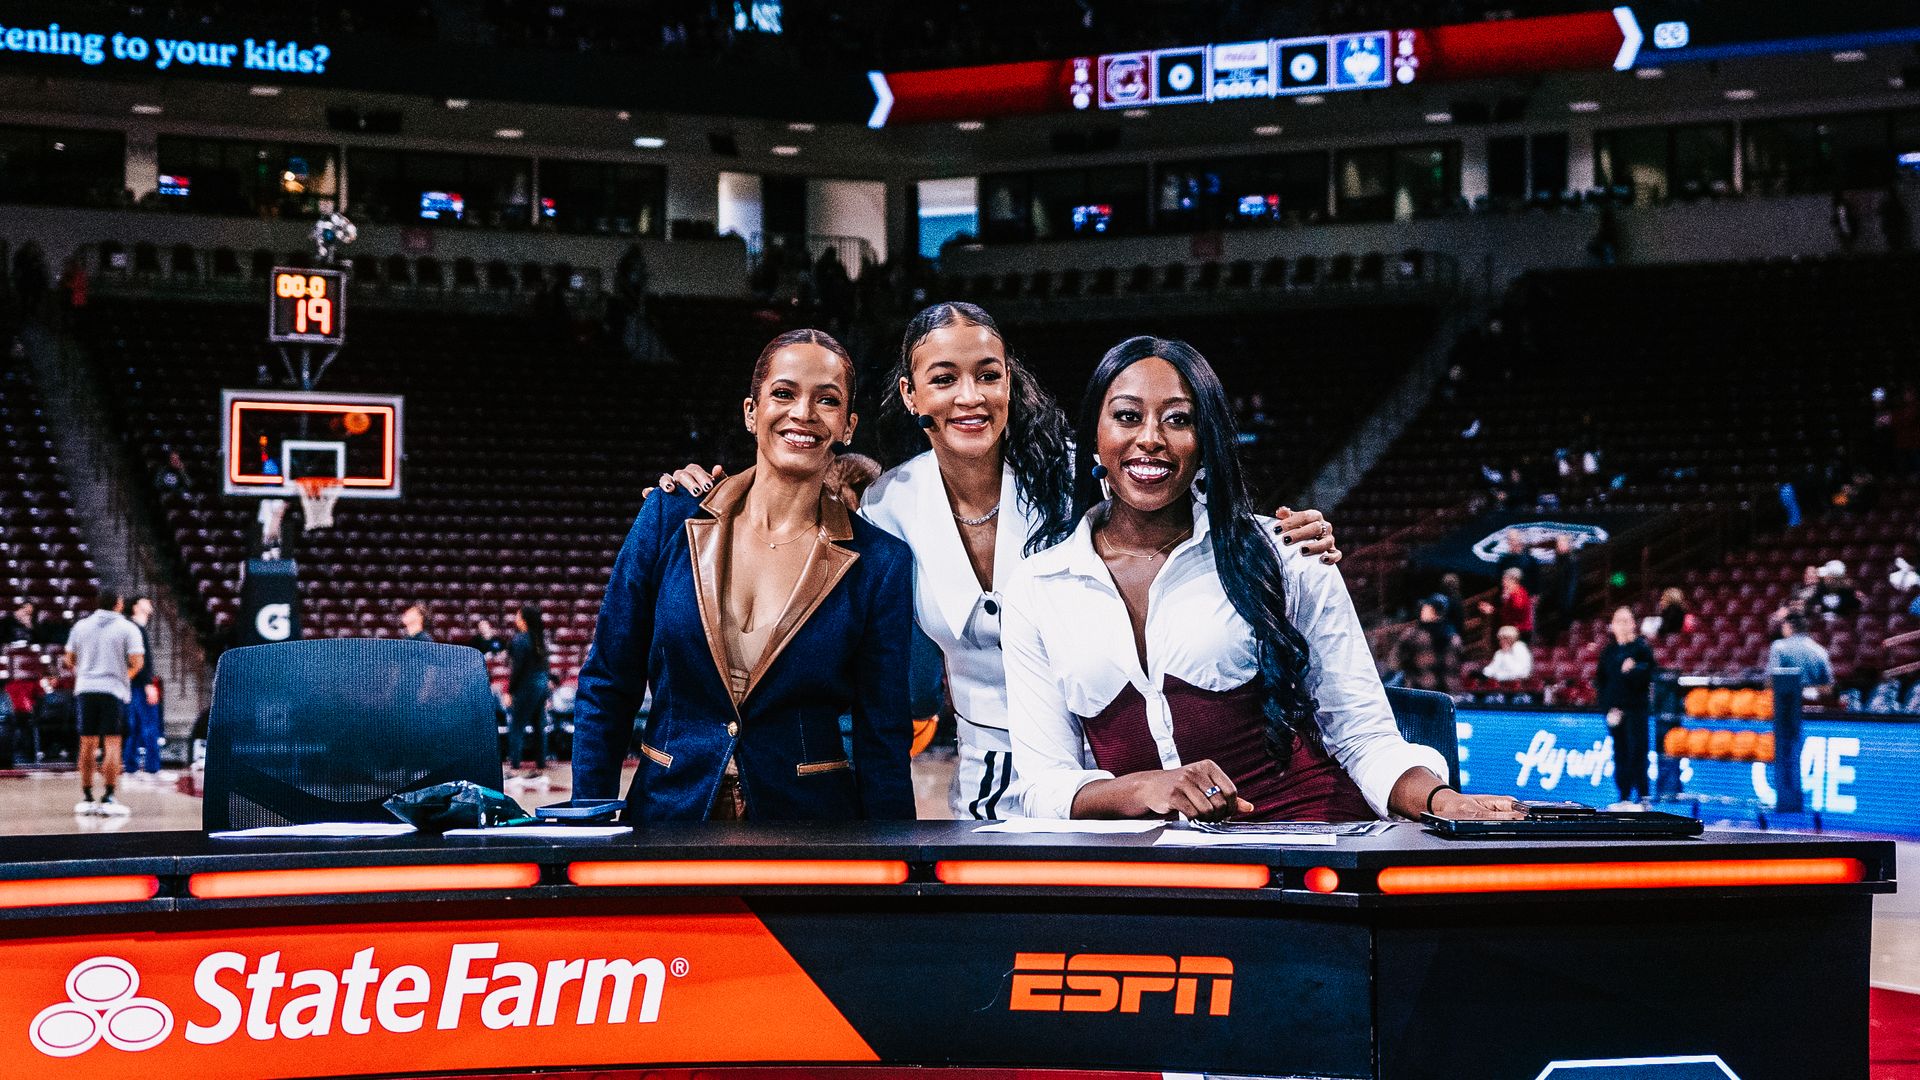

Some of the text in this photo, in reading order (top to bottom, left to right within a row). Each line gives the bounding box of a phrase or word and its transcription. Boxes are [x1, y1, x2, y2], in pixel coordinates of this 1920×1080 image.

[112, 32, 149, 60] to
[155, 38, 237, 69] your
[244, 38, 330, 73] kids?
[1290, 53, 1318, 82] 0
[1168, 63, 1195, 91] 0
[296, 298, 332, 335] 19
[255, 603, 291, 641] G
[1009, 952, 1235, 1017] ESPN
